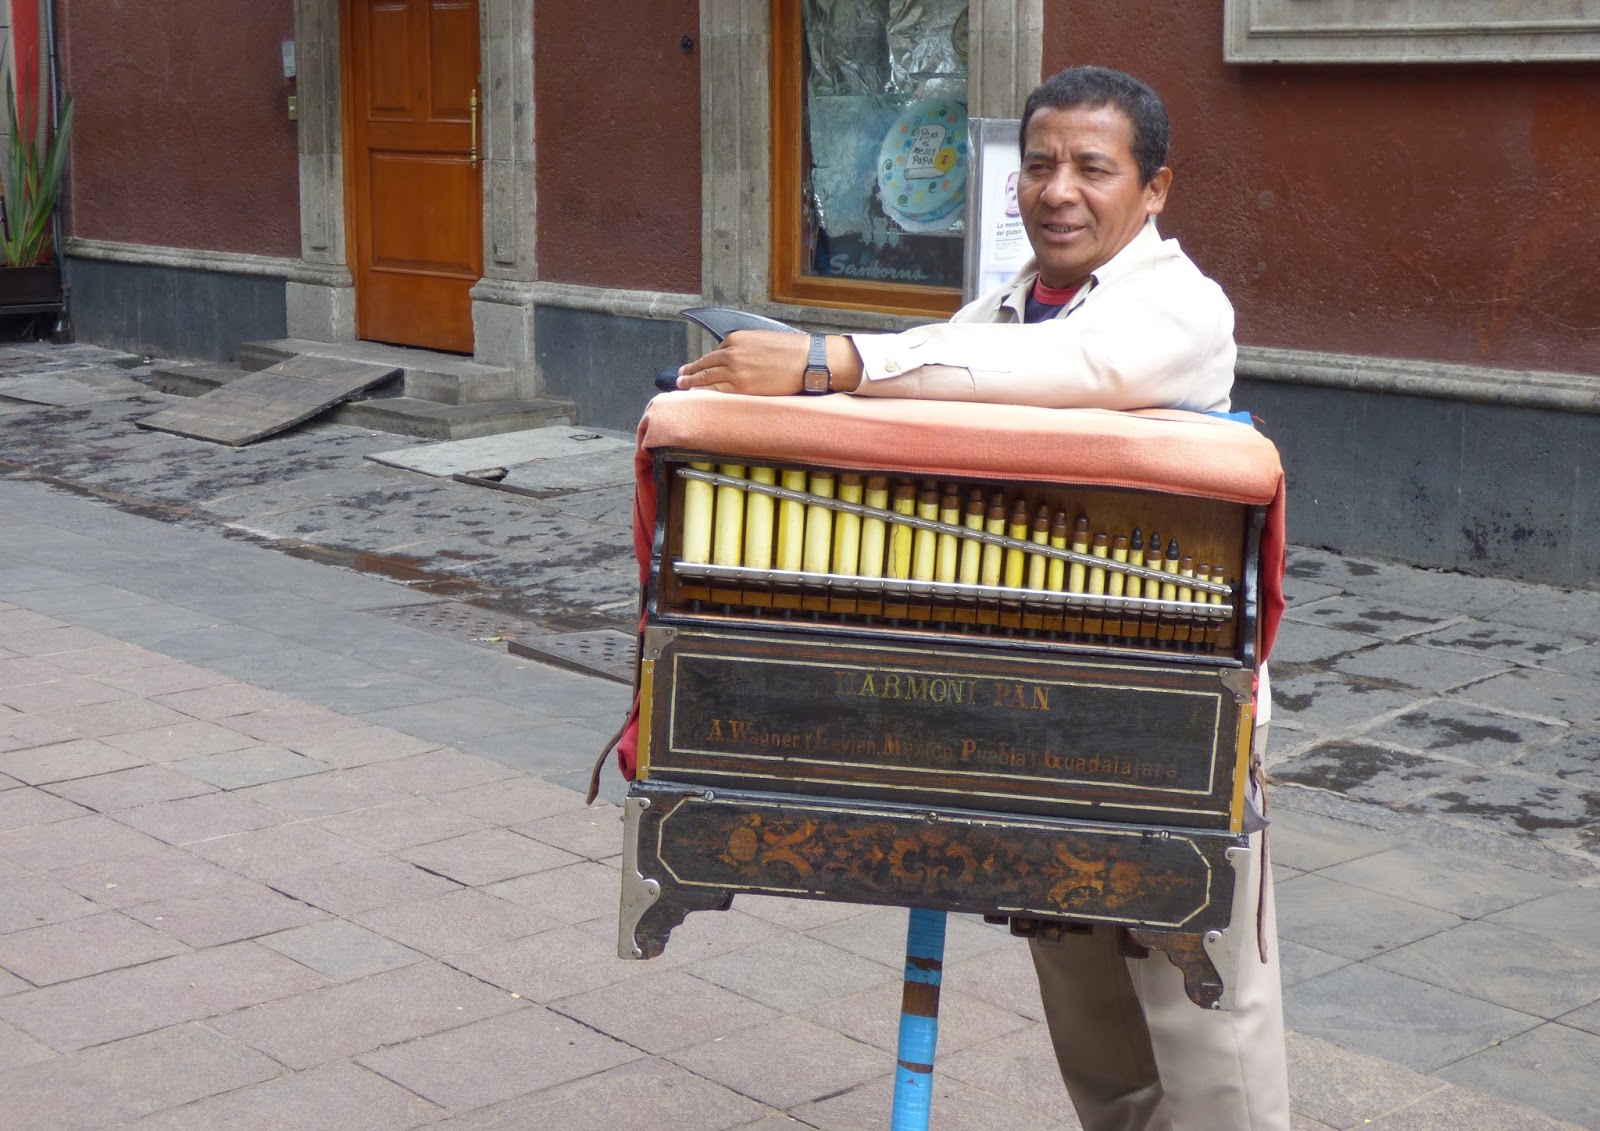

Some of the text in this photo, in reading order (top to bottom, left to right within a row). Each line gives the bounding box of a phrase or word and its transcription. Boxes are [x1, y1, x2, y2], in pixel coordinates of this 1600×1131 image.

[830, 253, 928, 280] Sanborns
[993, 682, 1050, 711] PAN
[1043, 744, 1180, 780] Guadalajara
